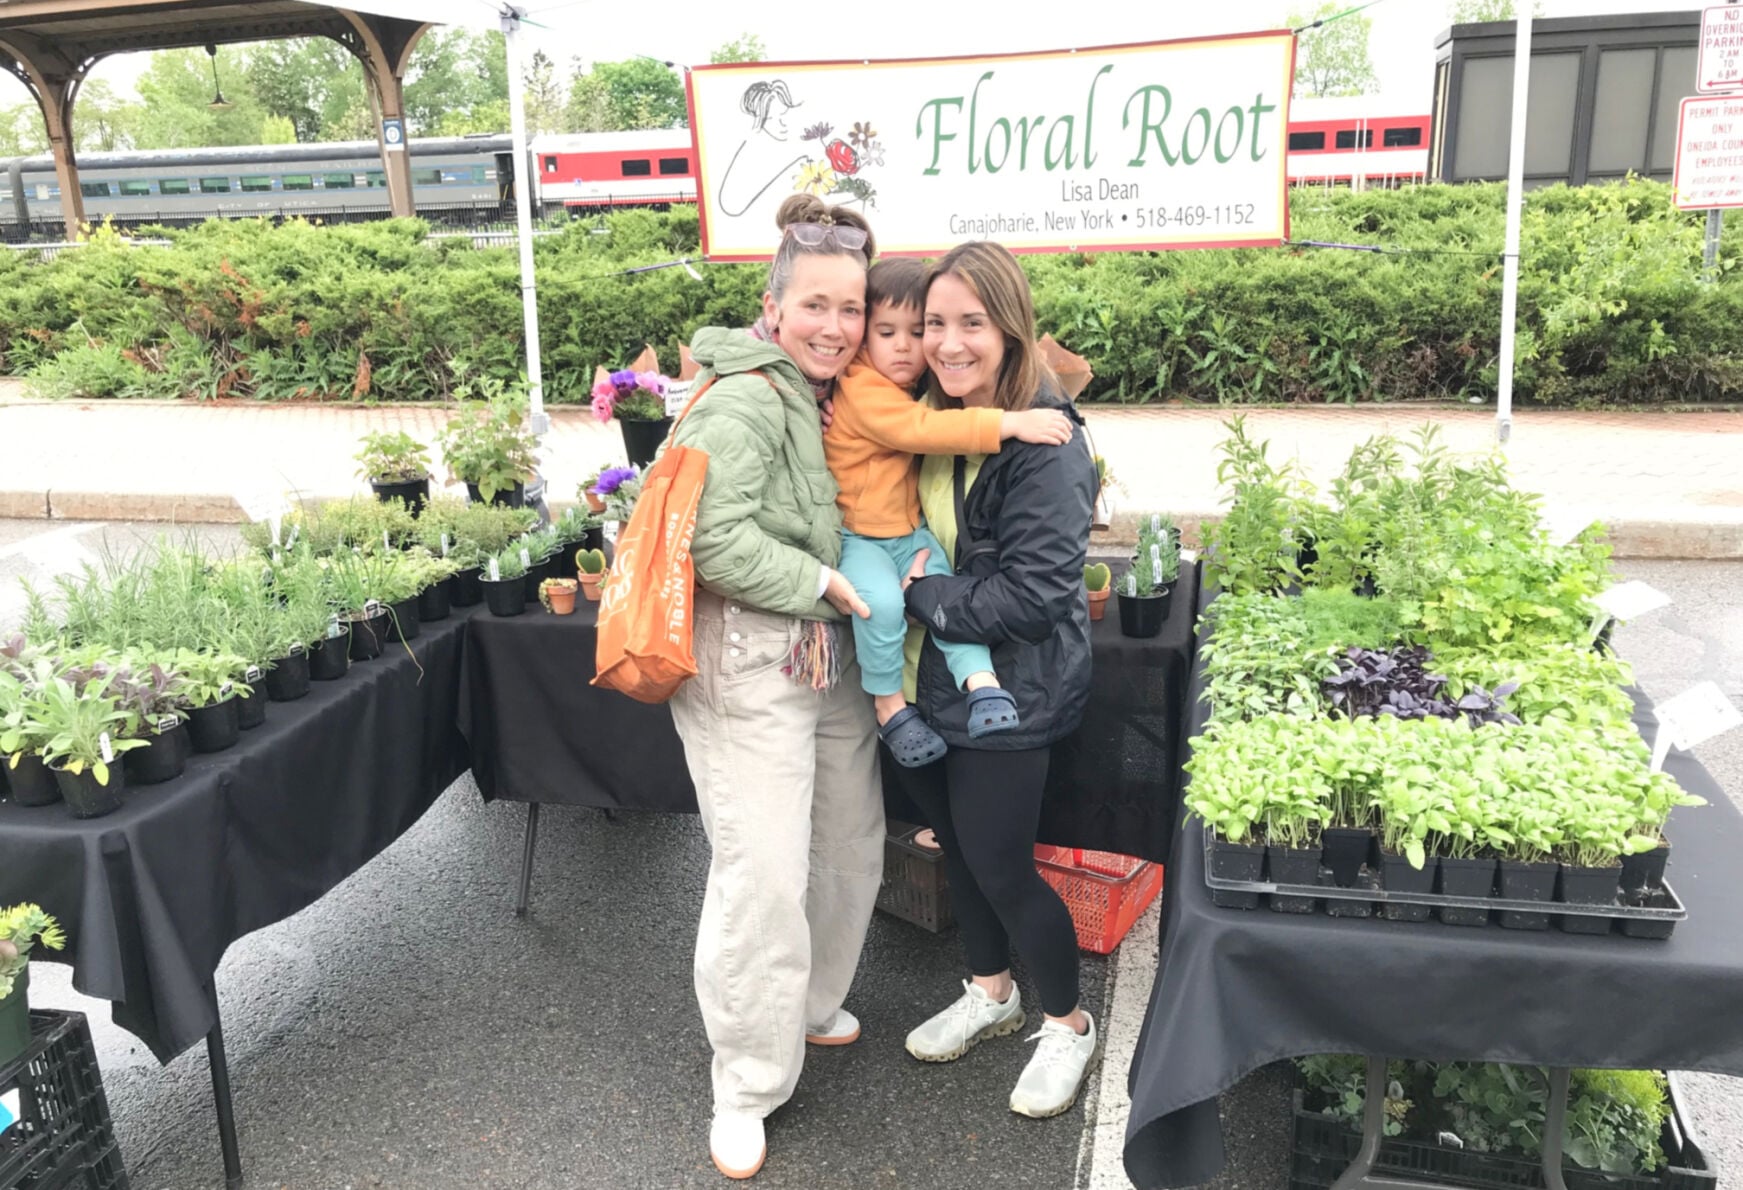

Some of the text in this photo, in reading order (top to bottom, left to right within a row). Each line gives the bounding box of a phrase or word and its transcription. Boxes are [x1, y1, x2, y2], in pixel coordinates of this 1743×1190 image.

[1724, 10, 1740, 21] NO
[1706, 23, 1743, 36] OVERNIG
[1705, 36, 1743, 49] PARKI
[916, 64, 1277, 176] Floral Root
[1062, 178, 1139, 203] Lisa Dean
[949, 203, 1255, 240] Canajoharie, New York 518-469-1152
